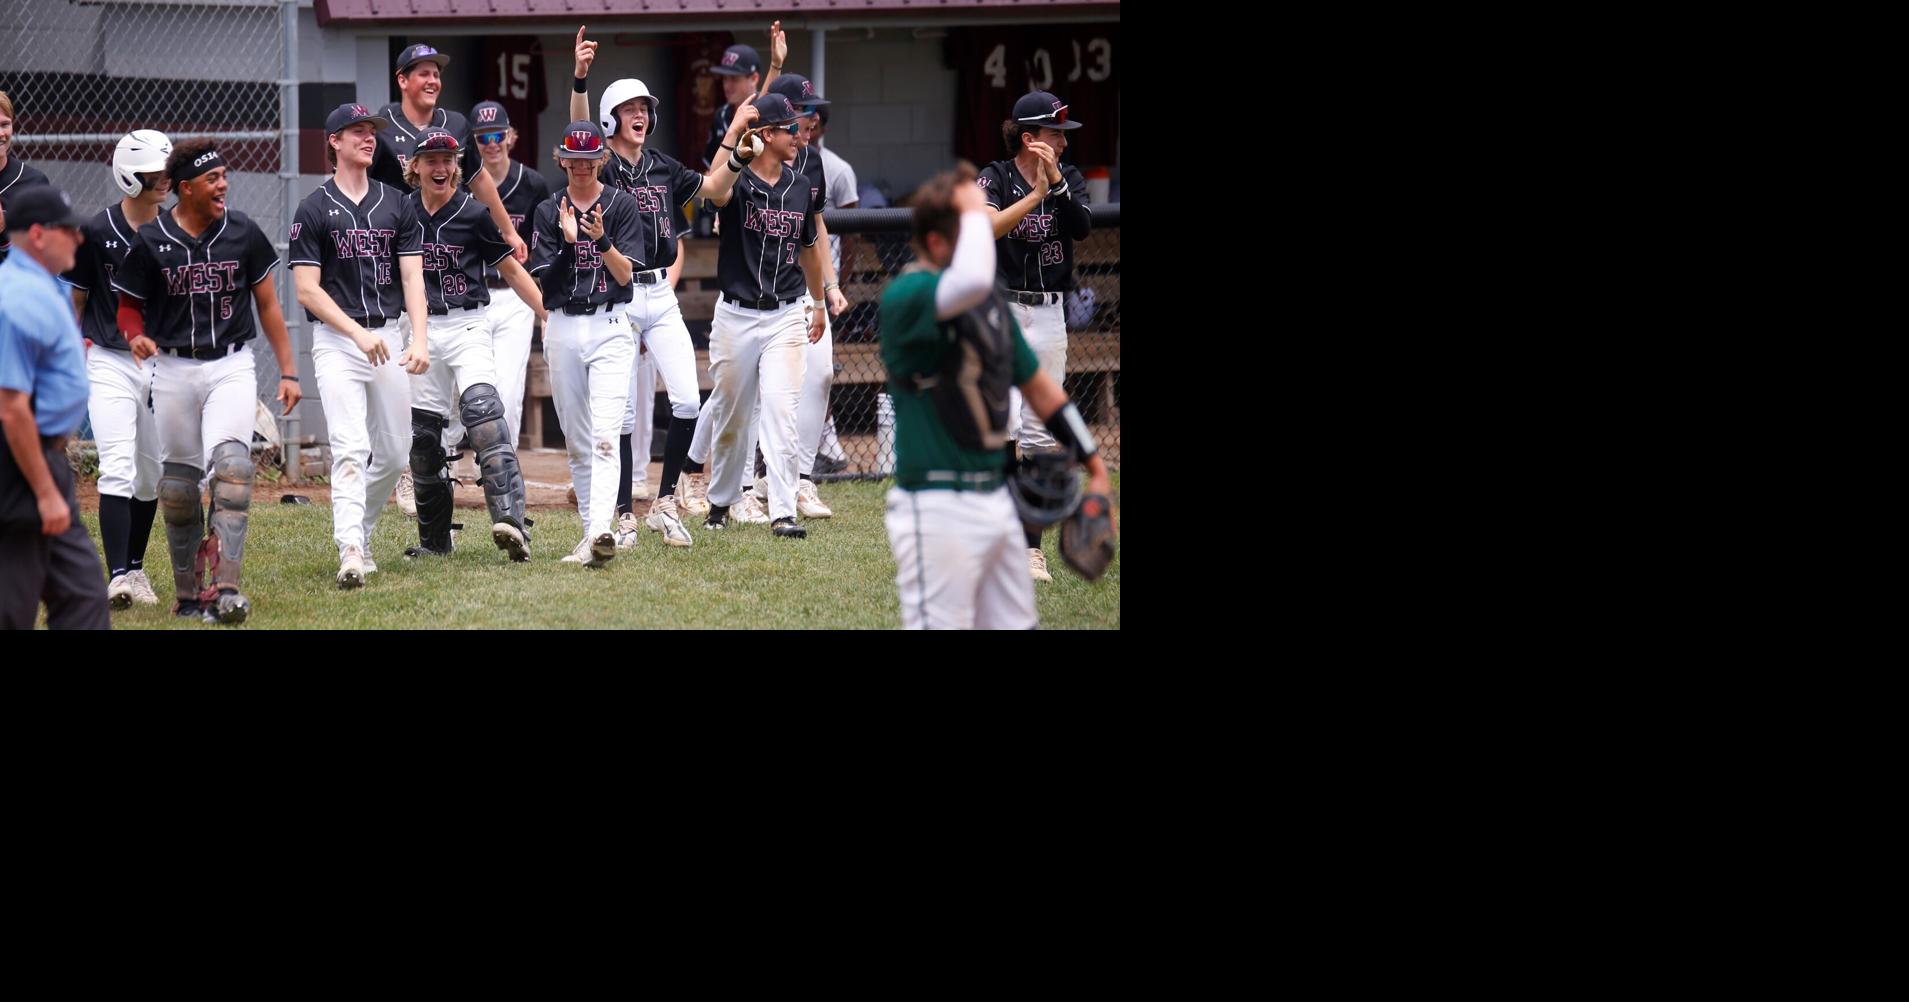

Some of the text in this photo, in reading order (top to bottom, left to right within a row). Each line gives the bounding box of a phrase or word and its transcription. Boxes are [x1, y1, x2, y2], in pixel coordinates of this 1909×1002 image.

[497, 51, 530, 99] 15
[744, 201, 803, 238] WEST
[331, 230, 395, 258] WEST
[421, 243, 464, 270] EST
[575, 241, 602, 268] ES
[786, 243, 796, 263] 7
[1041, 241, 1063, 266] 23
[162, 260, 239, 295] WEST
[443, 275, 467, 296] 26
[220, 297, 233, 320] 5
